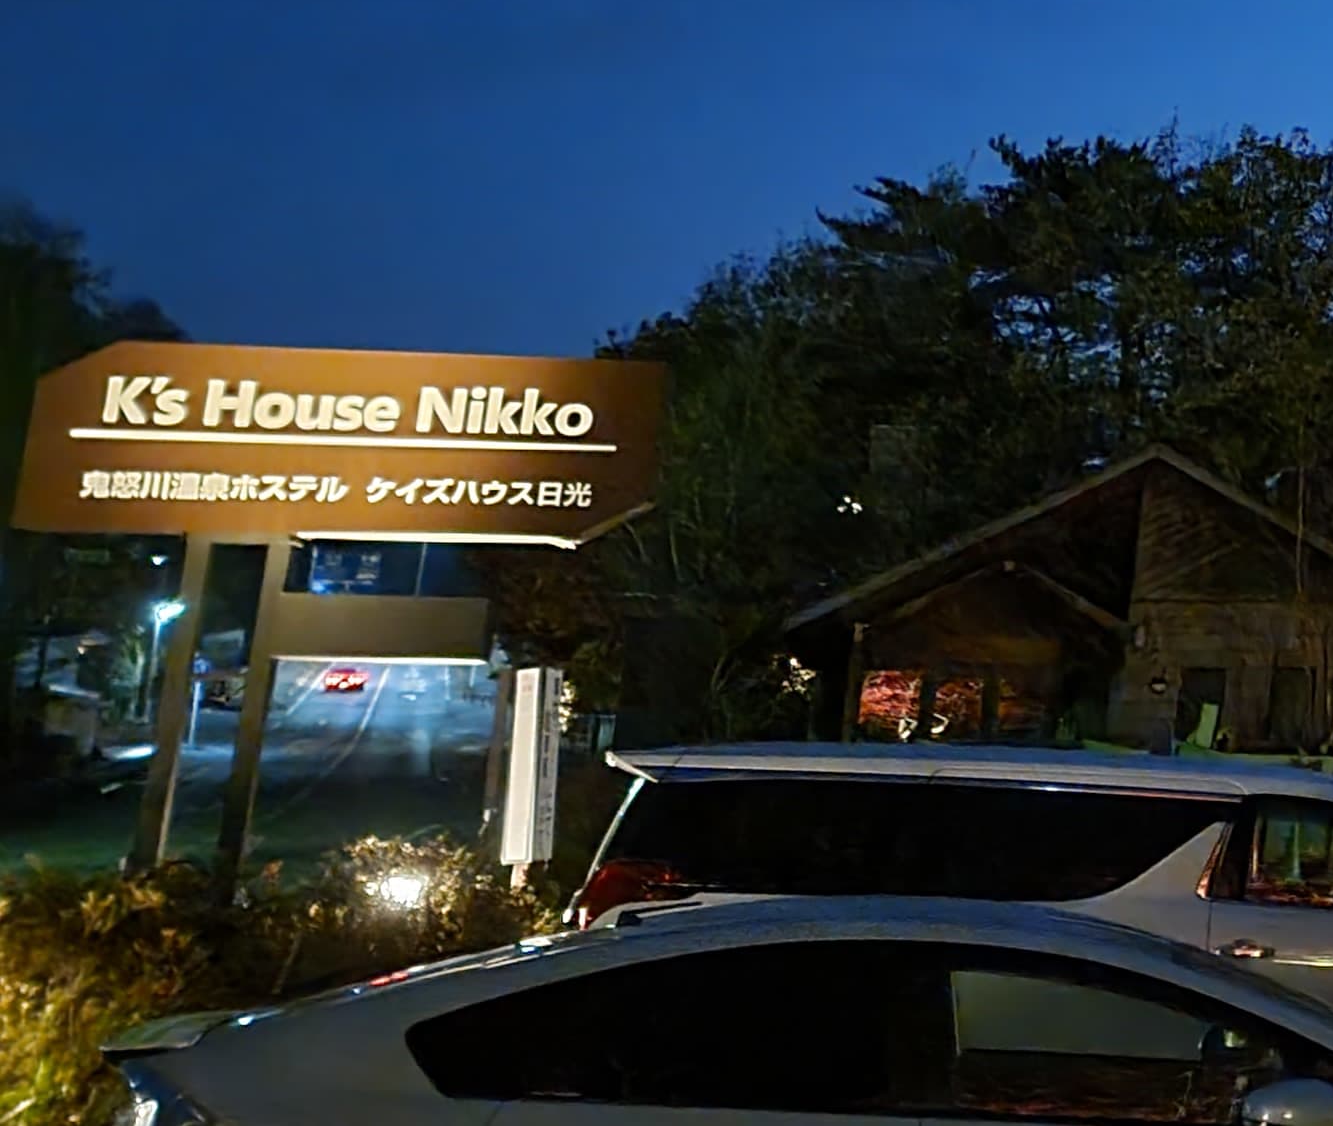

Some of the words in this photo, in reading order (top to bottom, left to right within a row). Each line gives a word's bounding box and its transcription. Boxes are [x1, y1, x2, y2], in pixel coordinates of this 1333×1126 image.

[102, 376, 188, 425] K's
[202, 379, 400, 433] House
[416, 386, 594, 436] Nikko
[79, 470, 349, 502] 鬼怒川温泉ホステル
[366, 476, 593, 507] ケイズハウス日光
